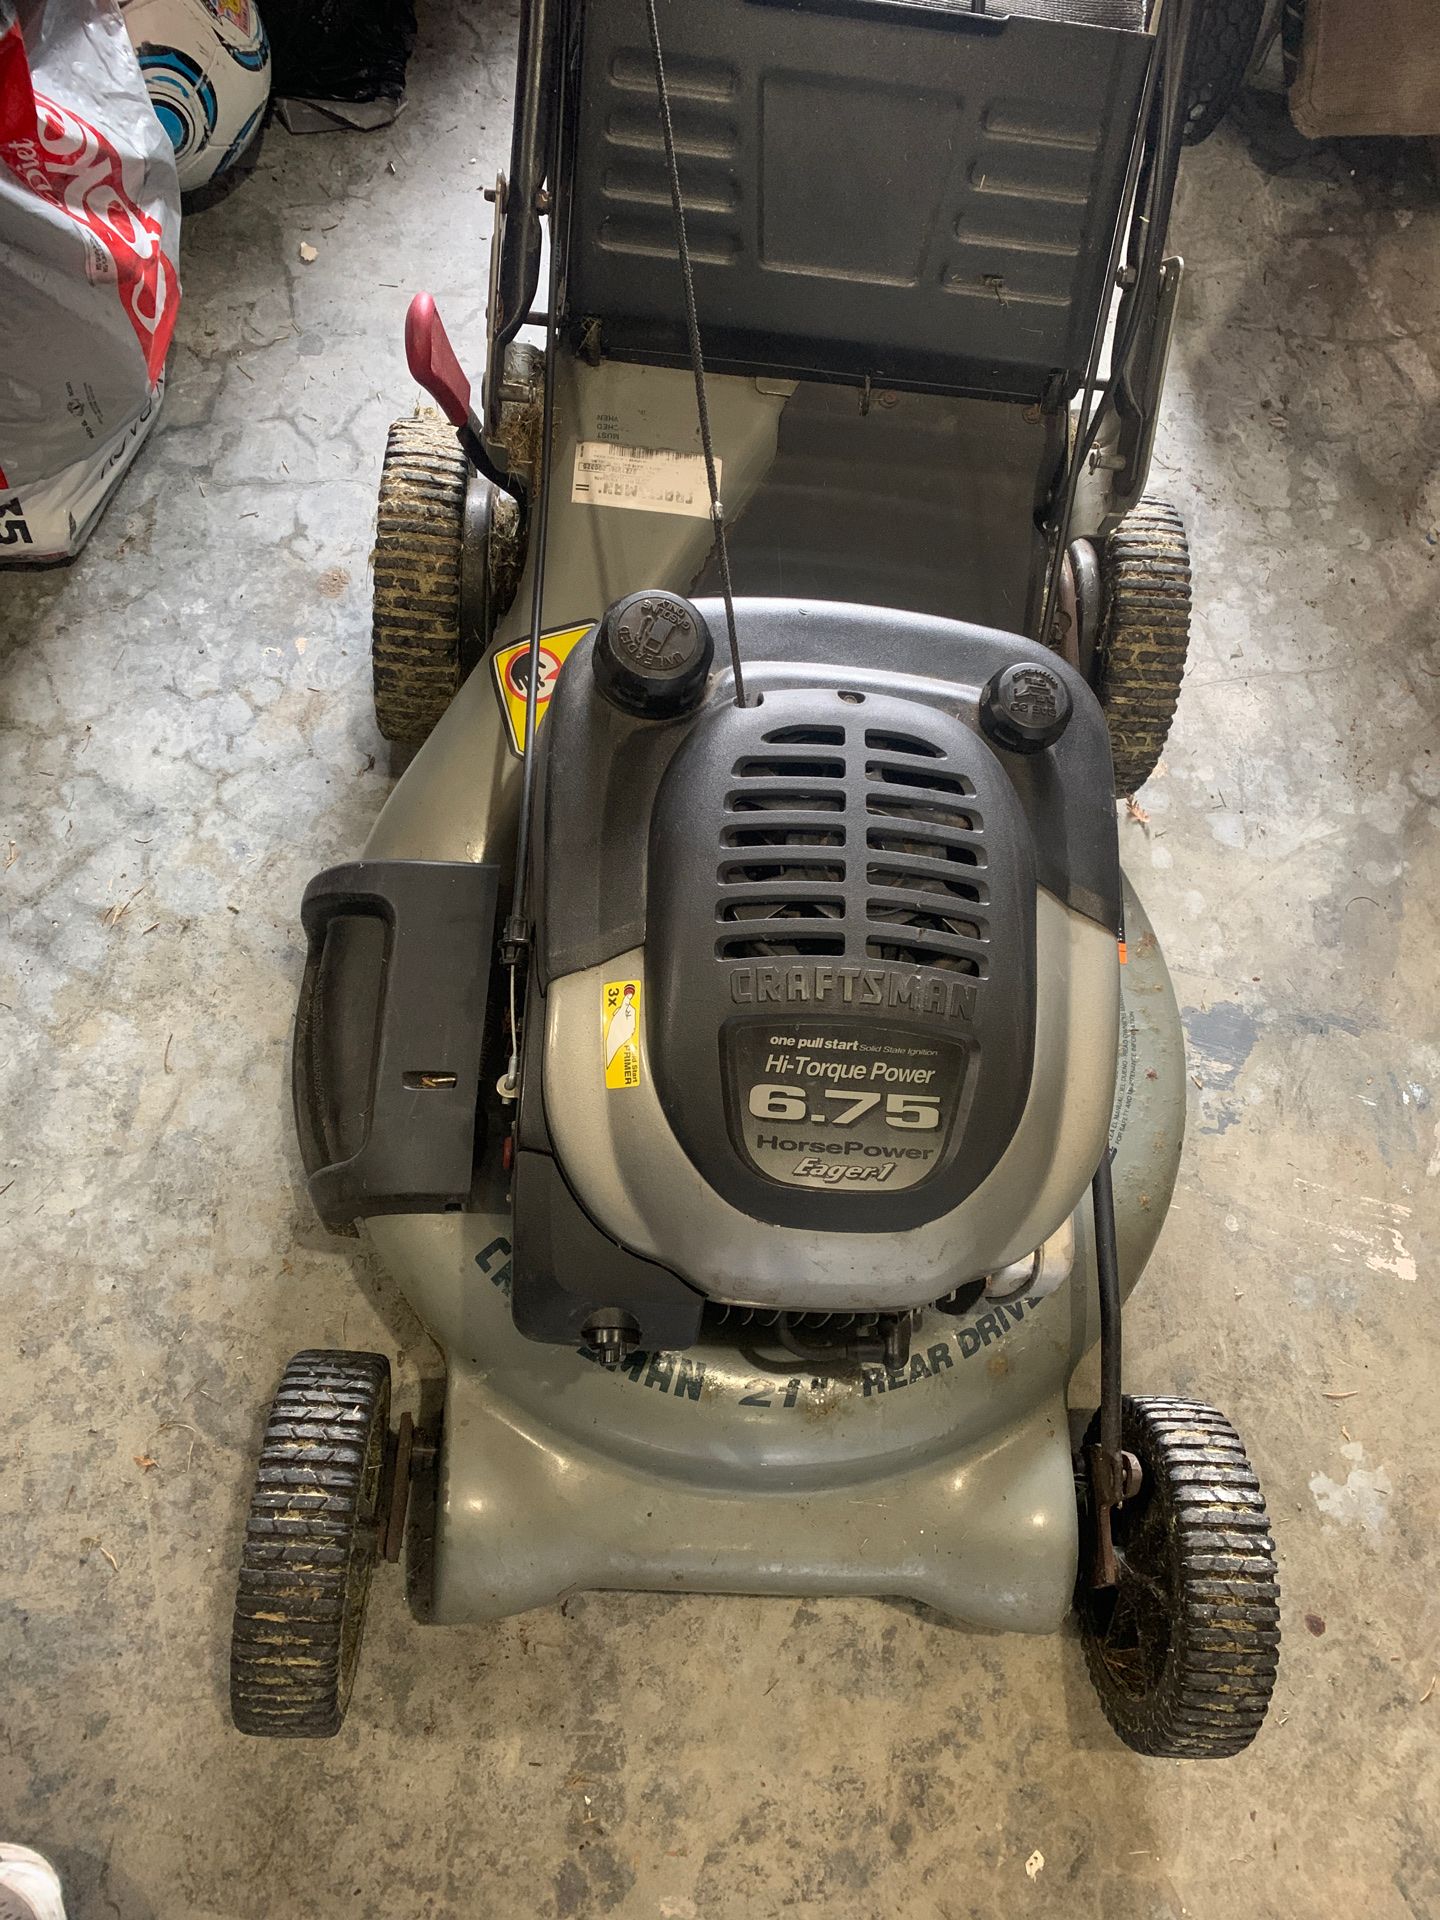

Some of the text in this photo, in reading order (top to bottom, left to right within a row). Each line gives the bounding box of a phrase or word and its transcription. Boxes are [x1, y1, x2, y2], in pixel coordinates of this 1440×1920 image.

[9, 138, 62, 207] Diet
[36, 96, 167, 335] Coke
[641, 600, 691, 631] GASOLINE
[617, 625, 685, 667] UNLEADED
[608, 987, 620, 1007] 3x
[730, 965, 978, 1020] CRAFTSMAN
[623, 1045, 632, 1085] PRIMER
[770, 1036, 938, 1057] one pull start Solid State Ignition
[765, 1054, 936, 1084] Hi-Torque Power
[748, 1083, 941, 1131] 6.75
[757, 1134, 934, 1160] HorsePower
[792, 1157, 897, 1184] Eager-1
[862, 1342, 954, 1398] REAR
